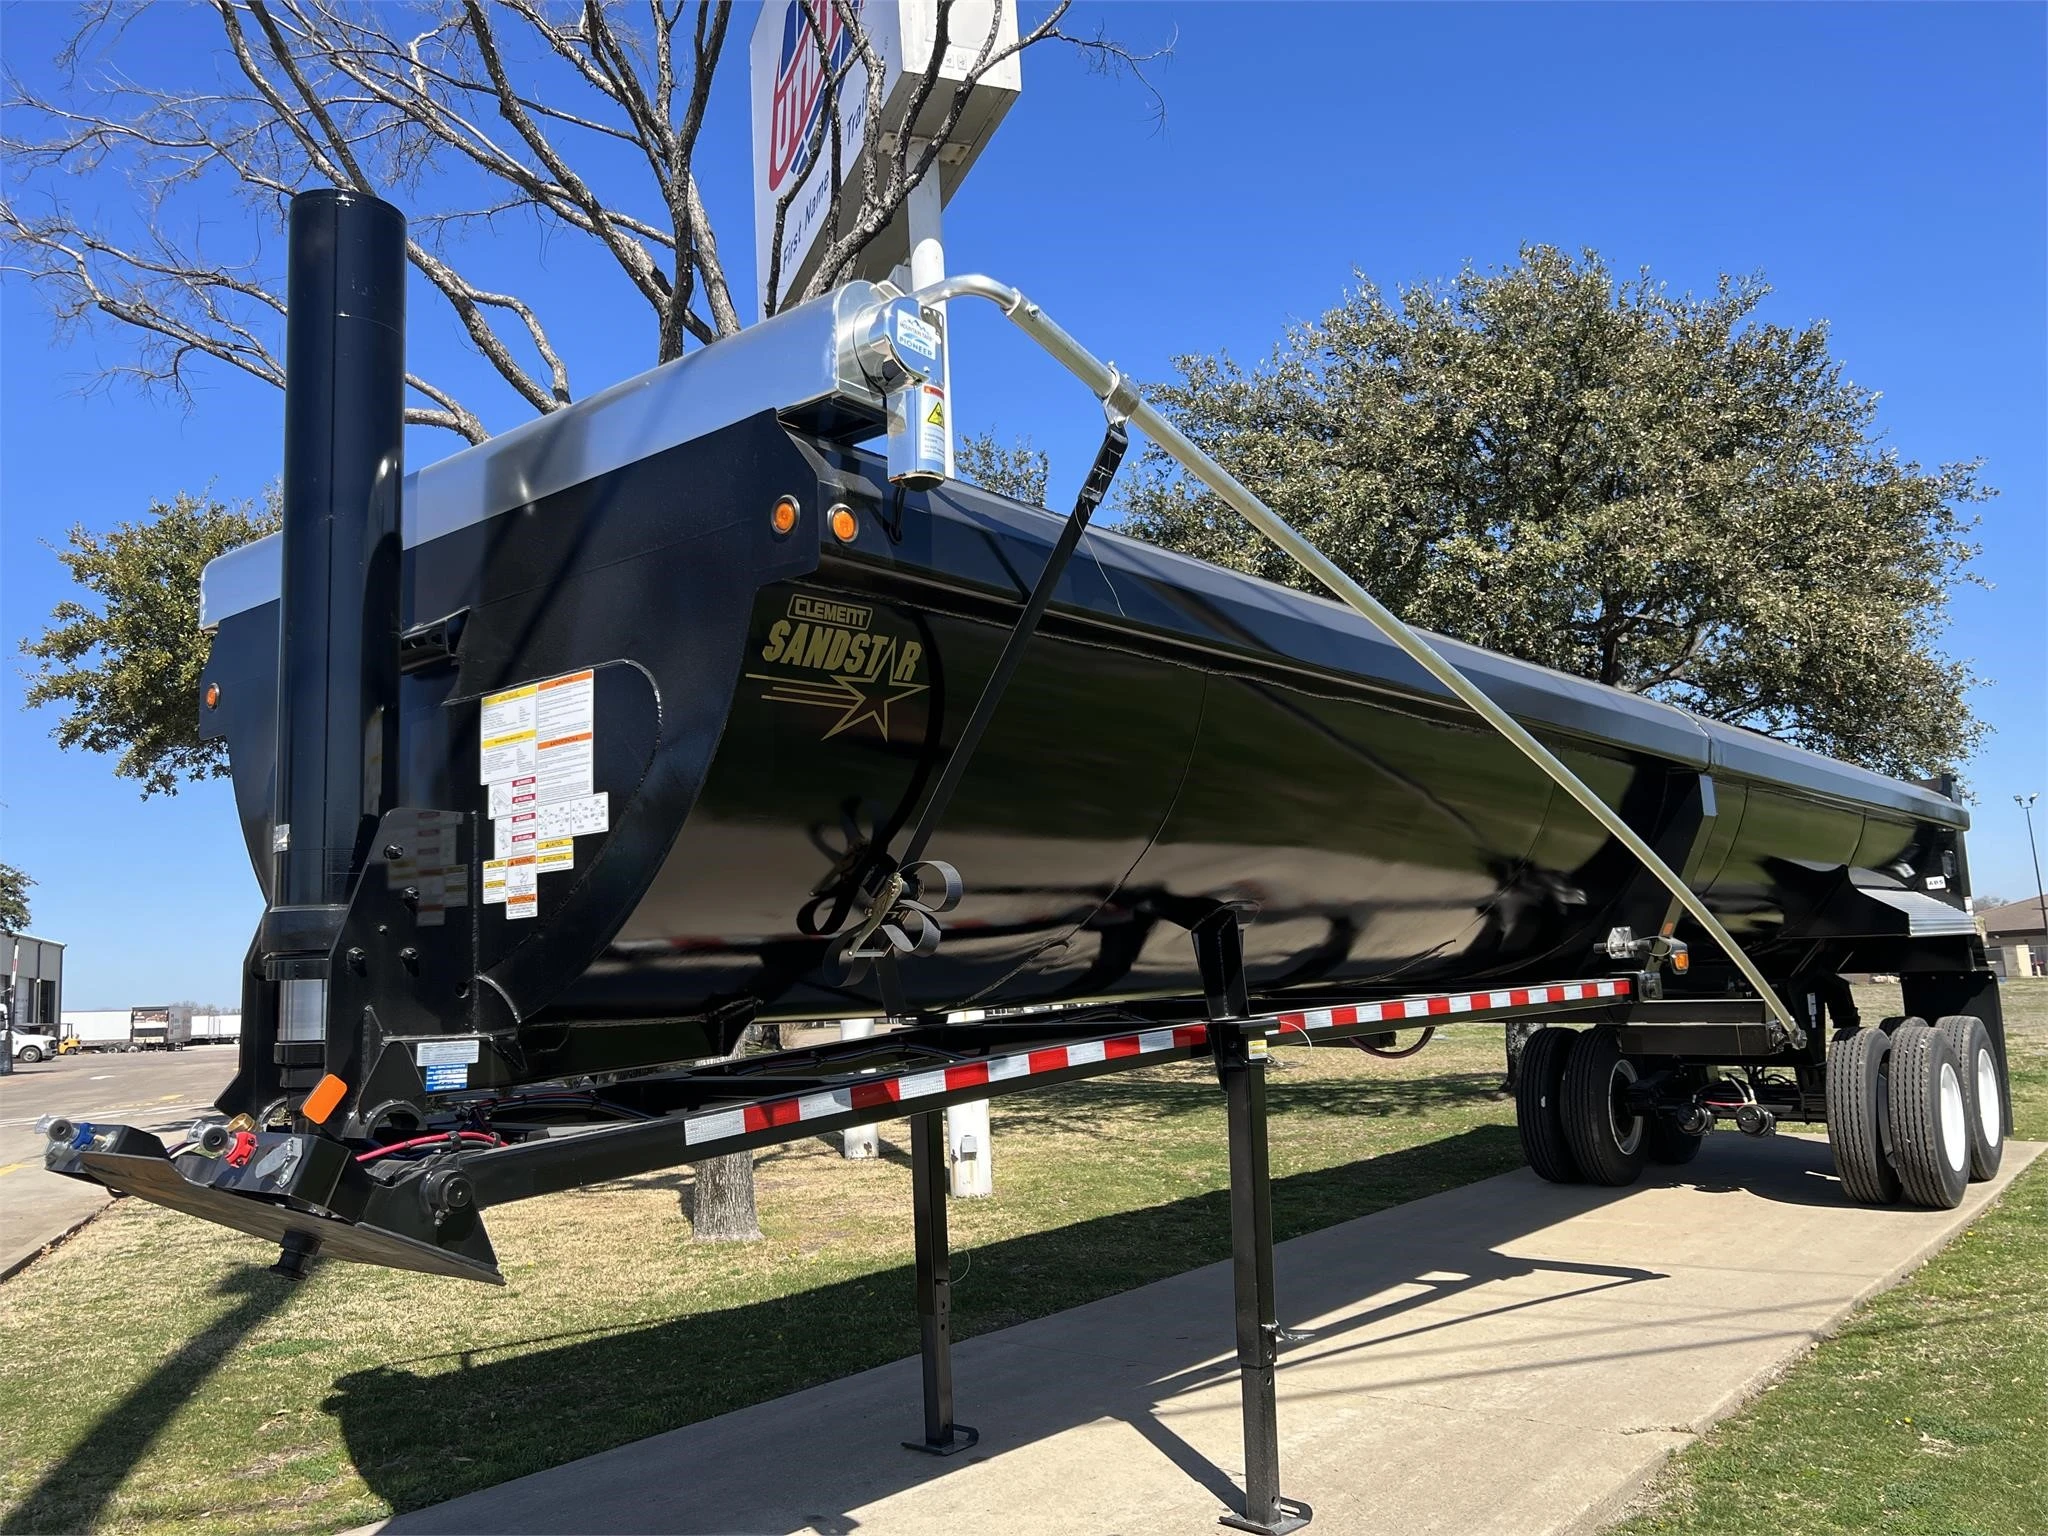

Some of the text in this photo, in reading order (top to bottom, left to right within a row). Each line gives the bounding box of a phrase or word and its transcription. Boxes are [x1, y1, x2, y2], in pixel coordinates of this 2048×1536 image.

[782, 220, 803, 274] First
[804, 169, 830, 232] Name
[899, 336, 933, 356] PIONEER
[794, 598, 867, 626] CLEMENT
